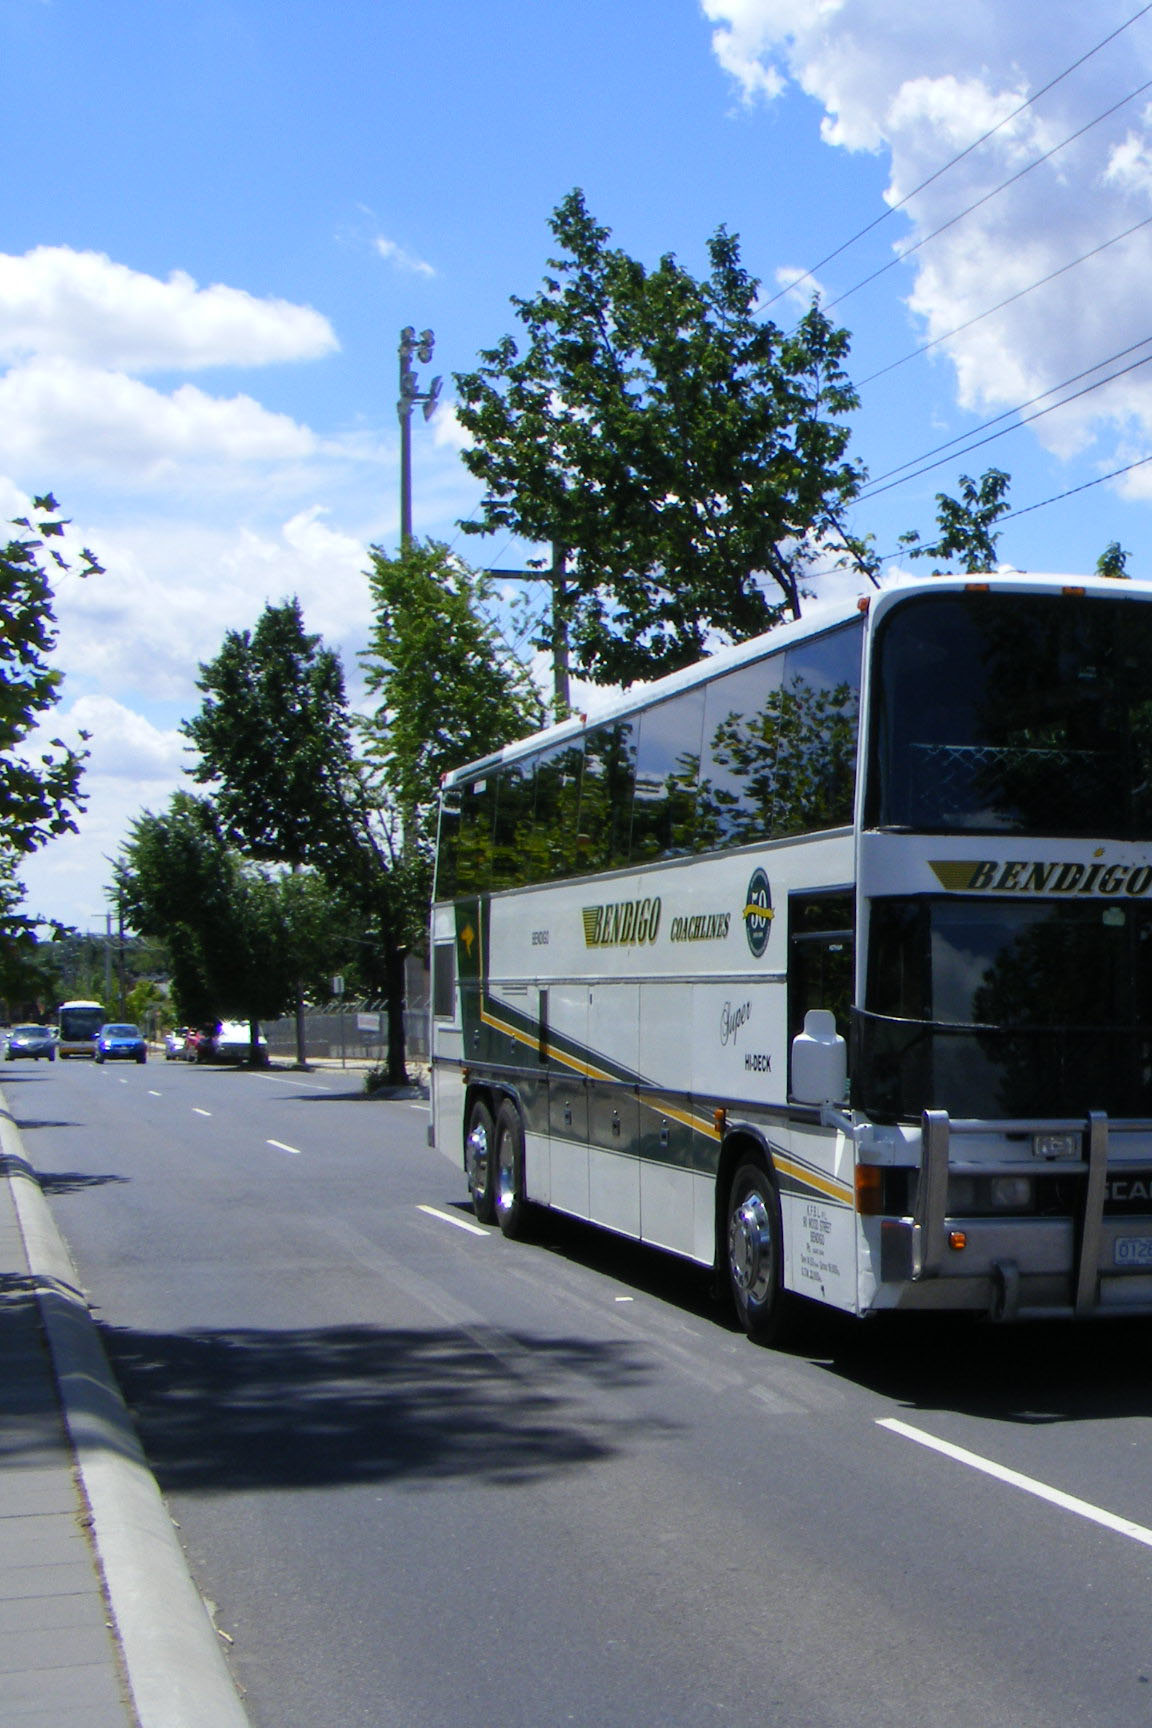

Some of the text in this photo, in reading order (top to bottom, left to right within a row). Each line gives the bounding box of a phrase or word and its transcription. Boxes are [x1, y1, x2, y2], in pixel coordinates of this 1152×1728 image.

[591, 896, 731, 948] BENDIGO COACHLINES
[720, 1001, 752, 1047] Super
[745, 1053, 772, 1073] HI-DECK
